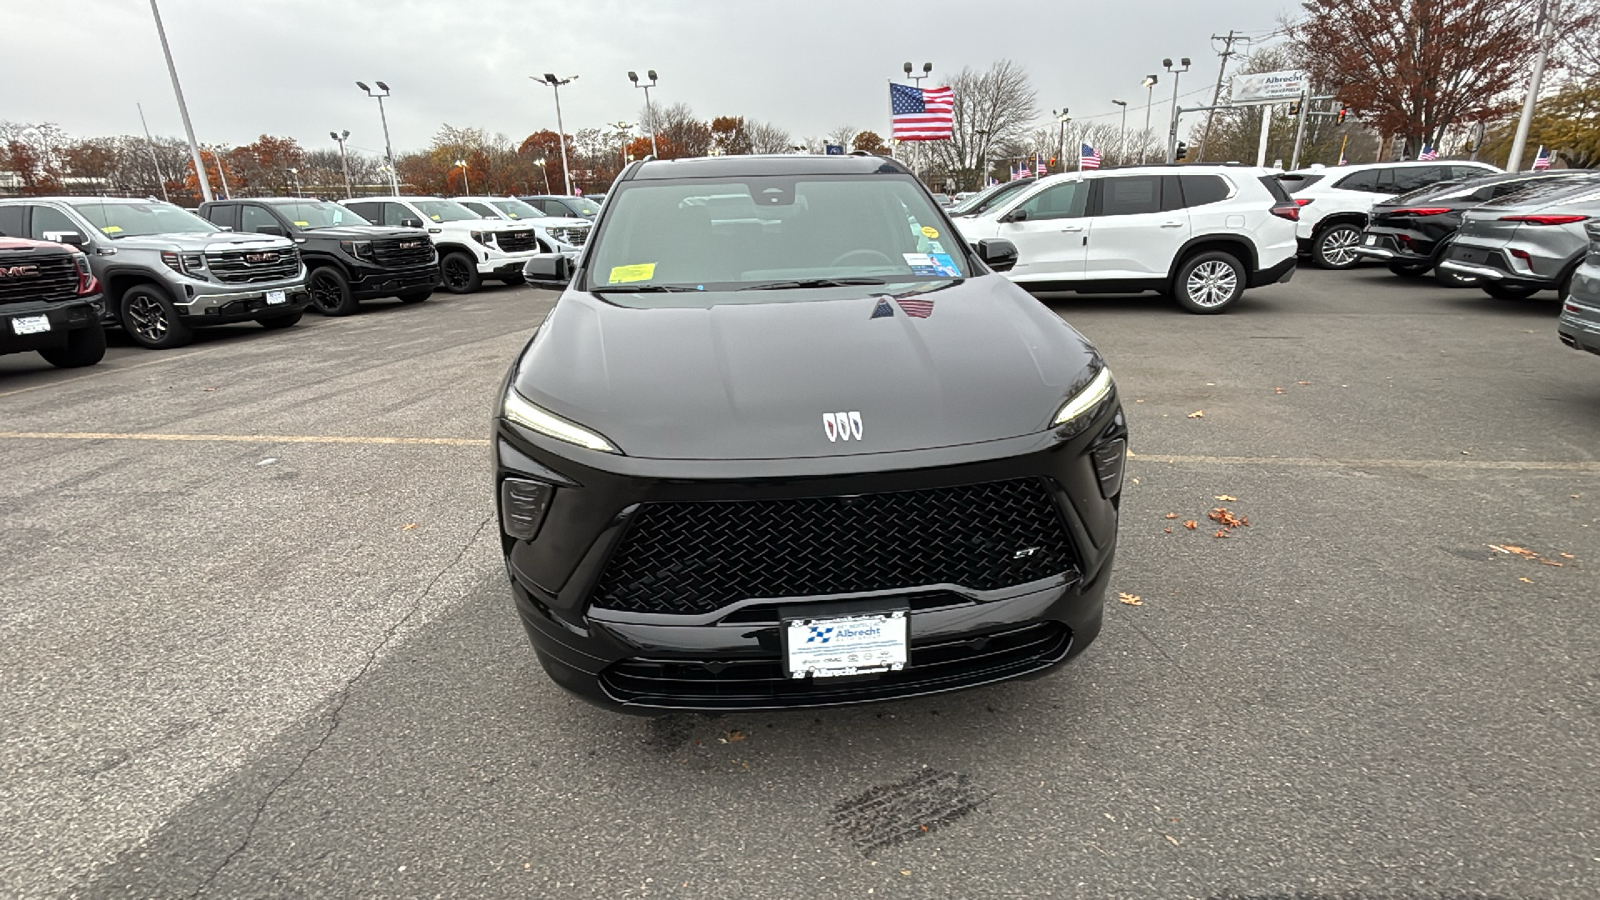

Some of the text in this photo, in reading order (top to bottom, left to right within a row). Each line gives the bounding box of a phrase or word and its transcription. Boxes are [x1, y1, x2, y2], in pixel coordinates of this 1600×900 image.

[1265, 72, 1302, 83] Albrecht
[246, 252, 279, 263] GMC
[0, 265, 39, 278] MC
[1013, 546, 1041, 559] ST
[835, 626, 880, 638] Albrecht
